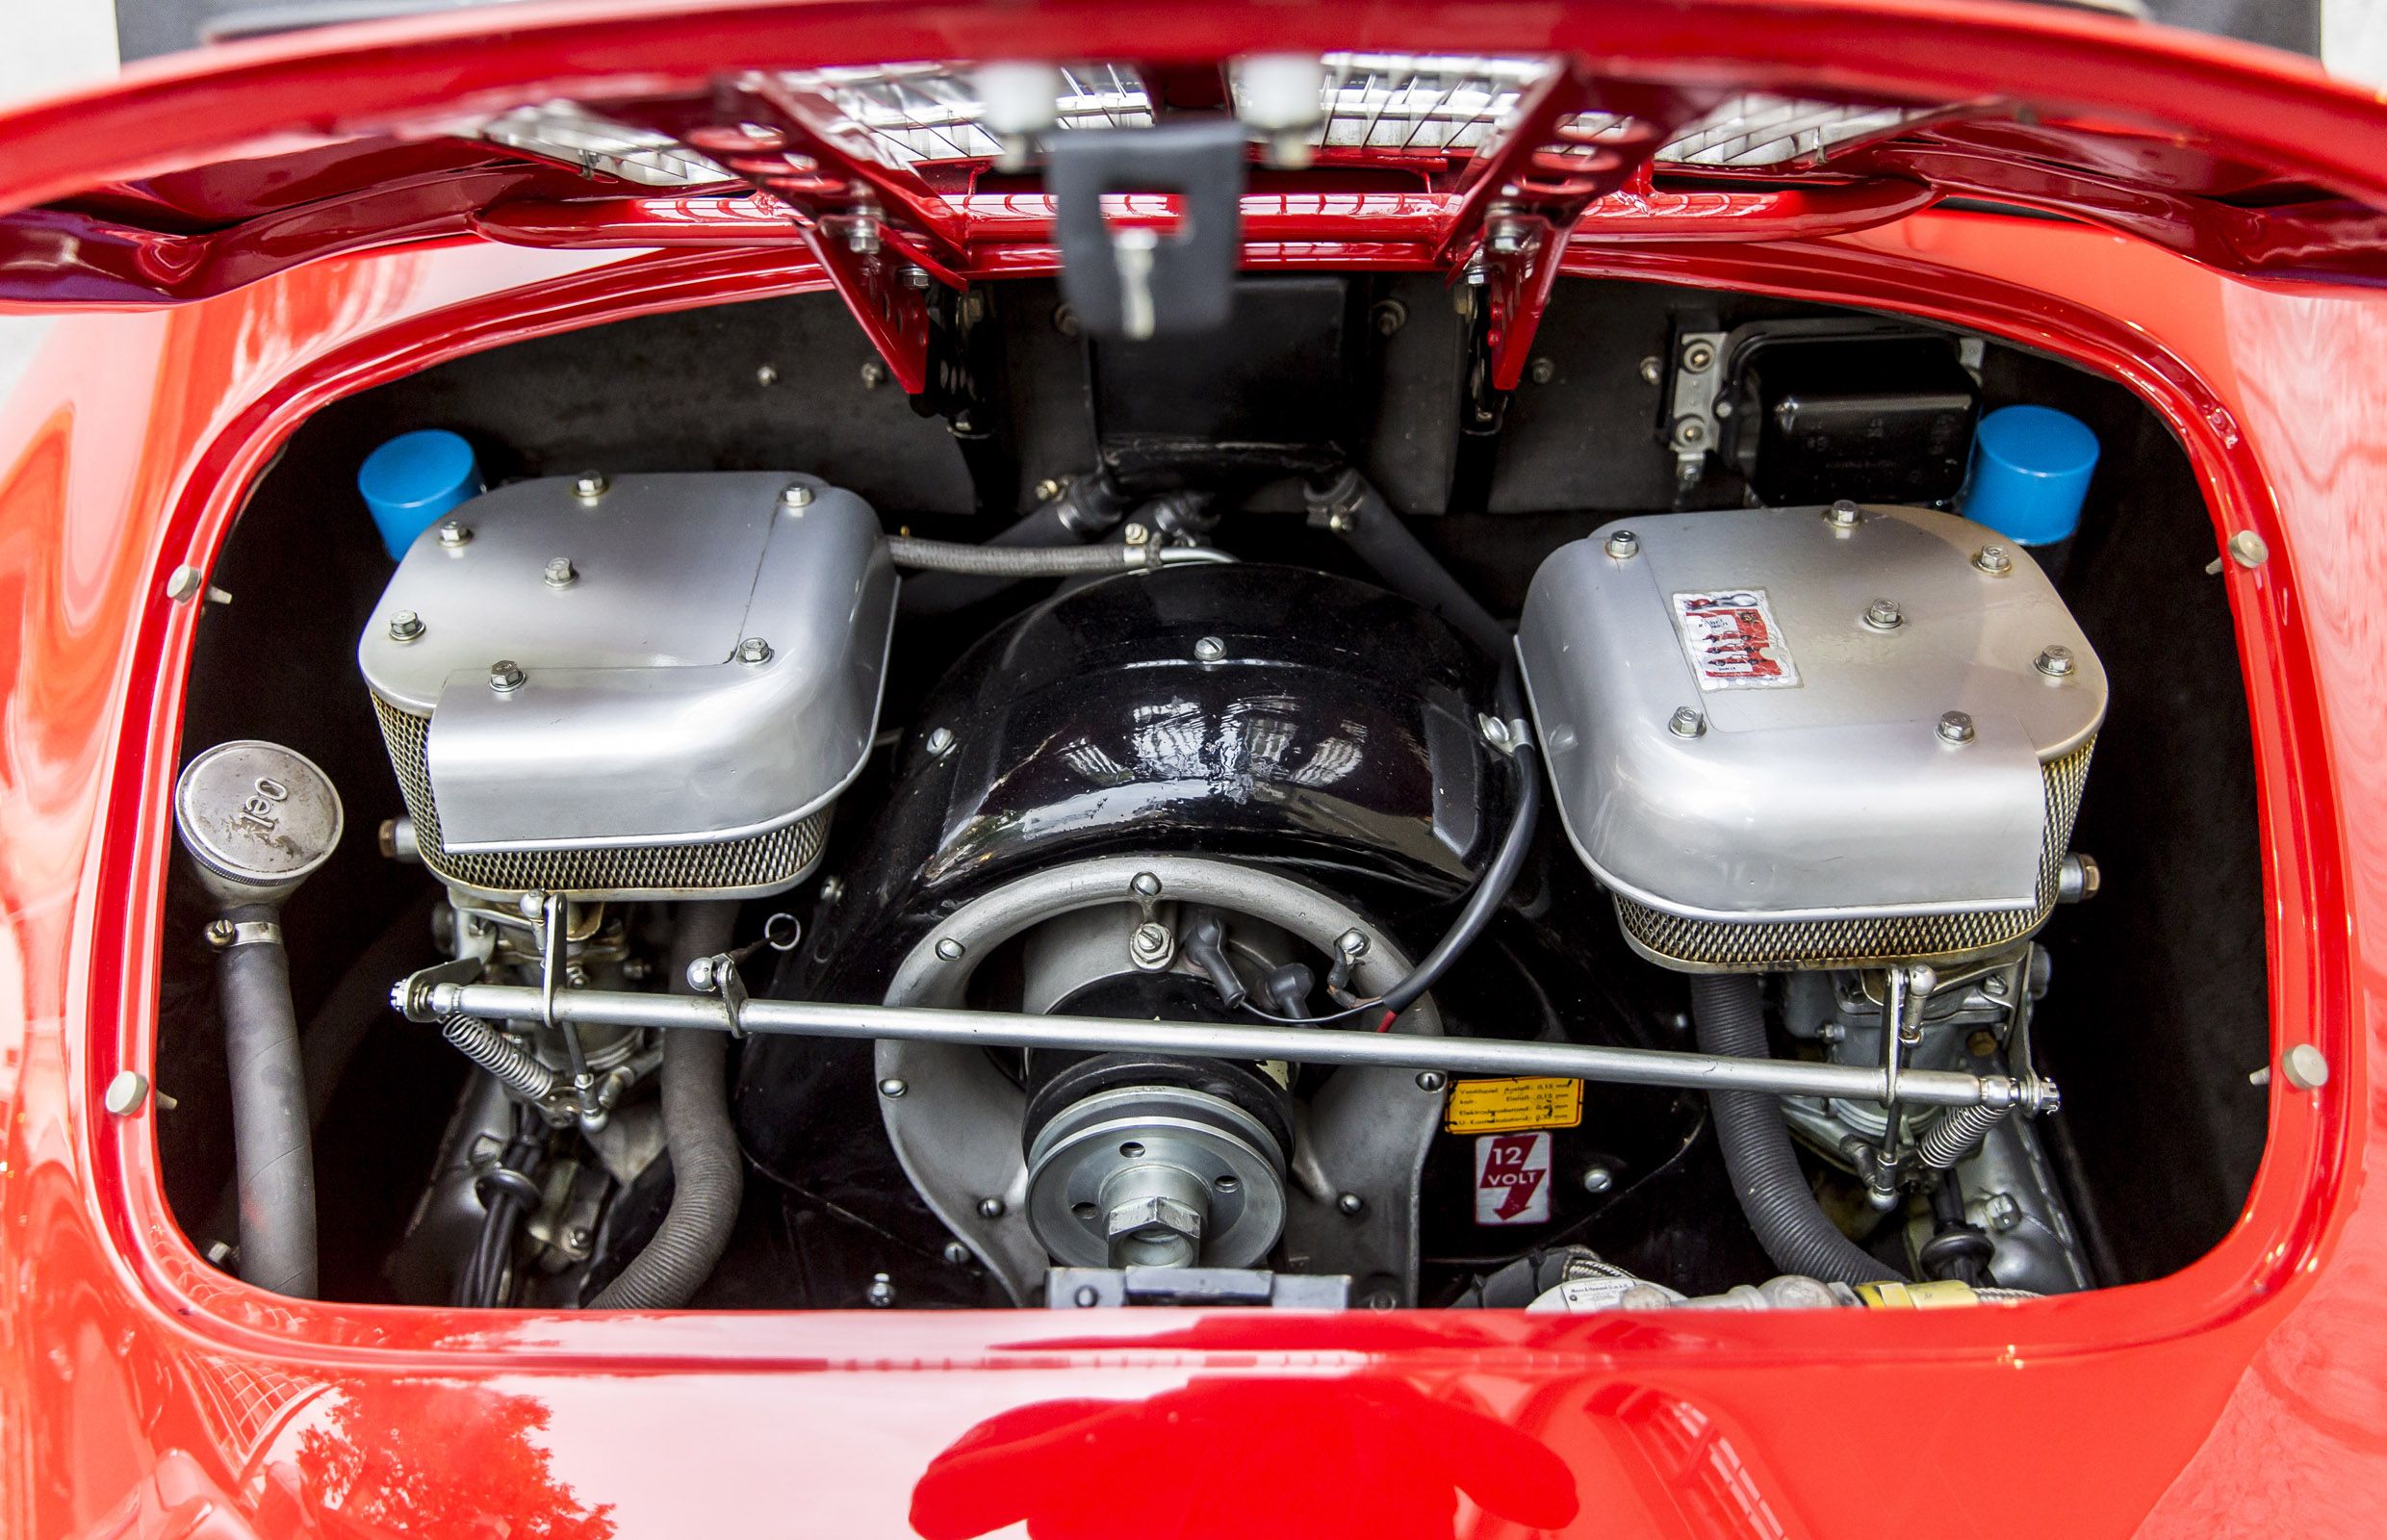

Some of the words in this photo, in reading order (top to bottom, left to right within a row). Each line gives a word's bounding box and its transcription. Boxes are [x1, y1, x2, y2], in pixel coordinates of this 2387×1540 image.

[240, 777, 288, 828] Oel
[1493, 1146, 1523, 1165] 12
[1487, 1171, 1537, 1186] VOLT
